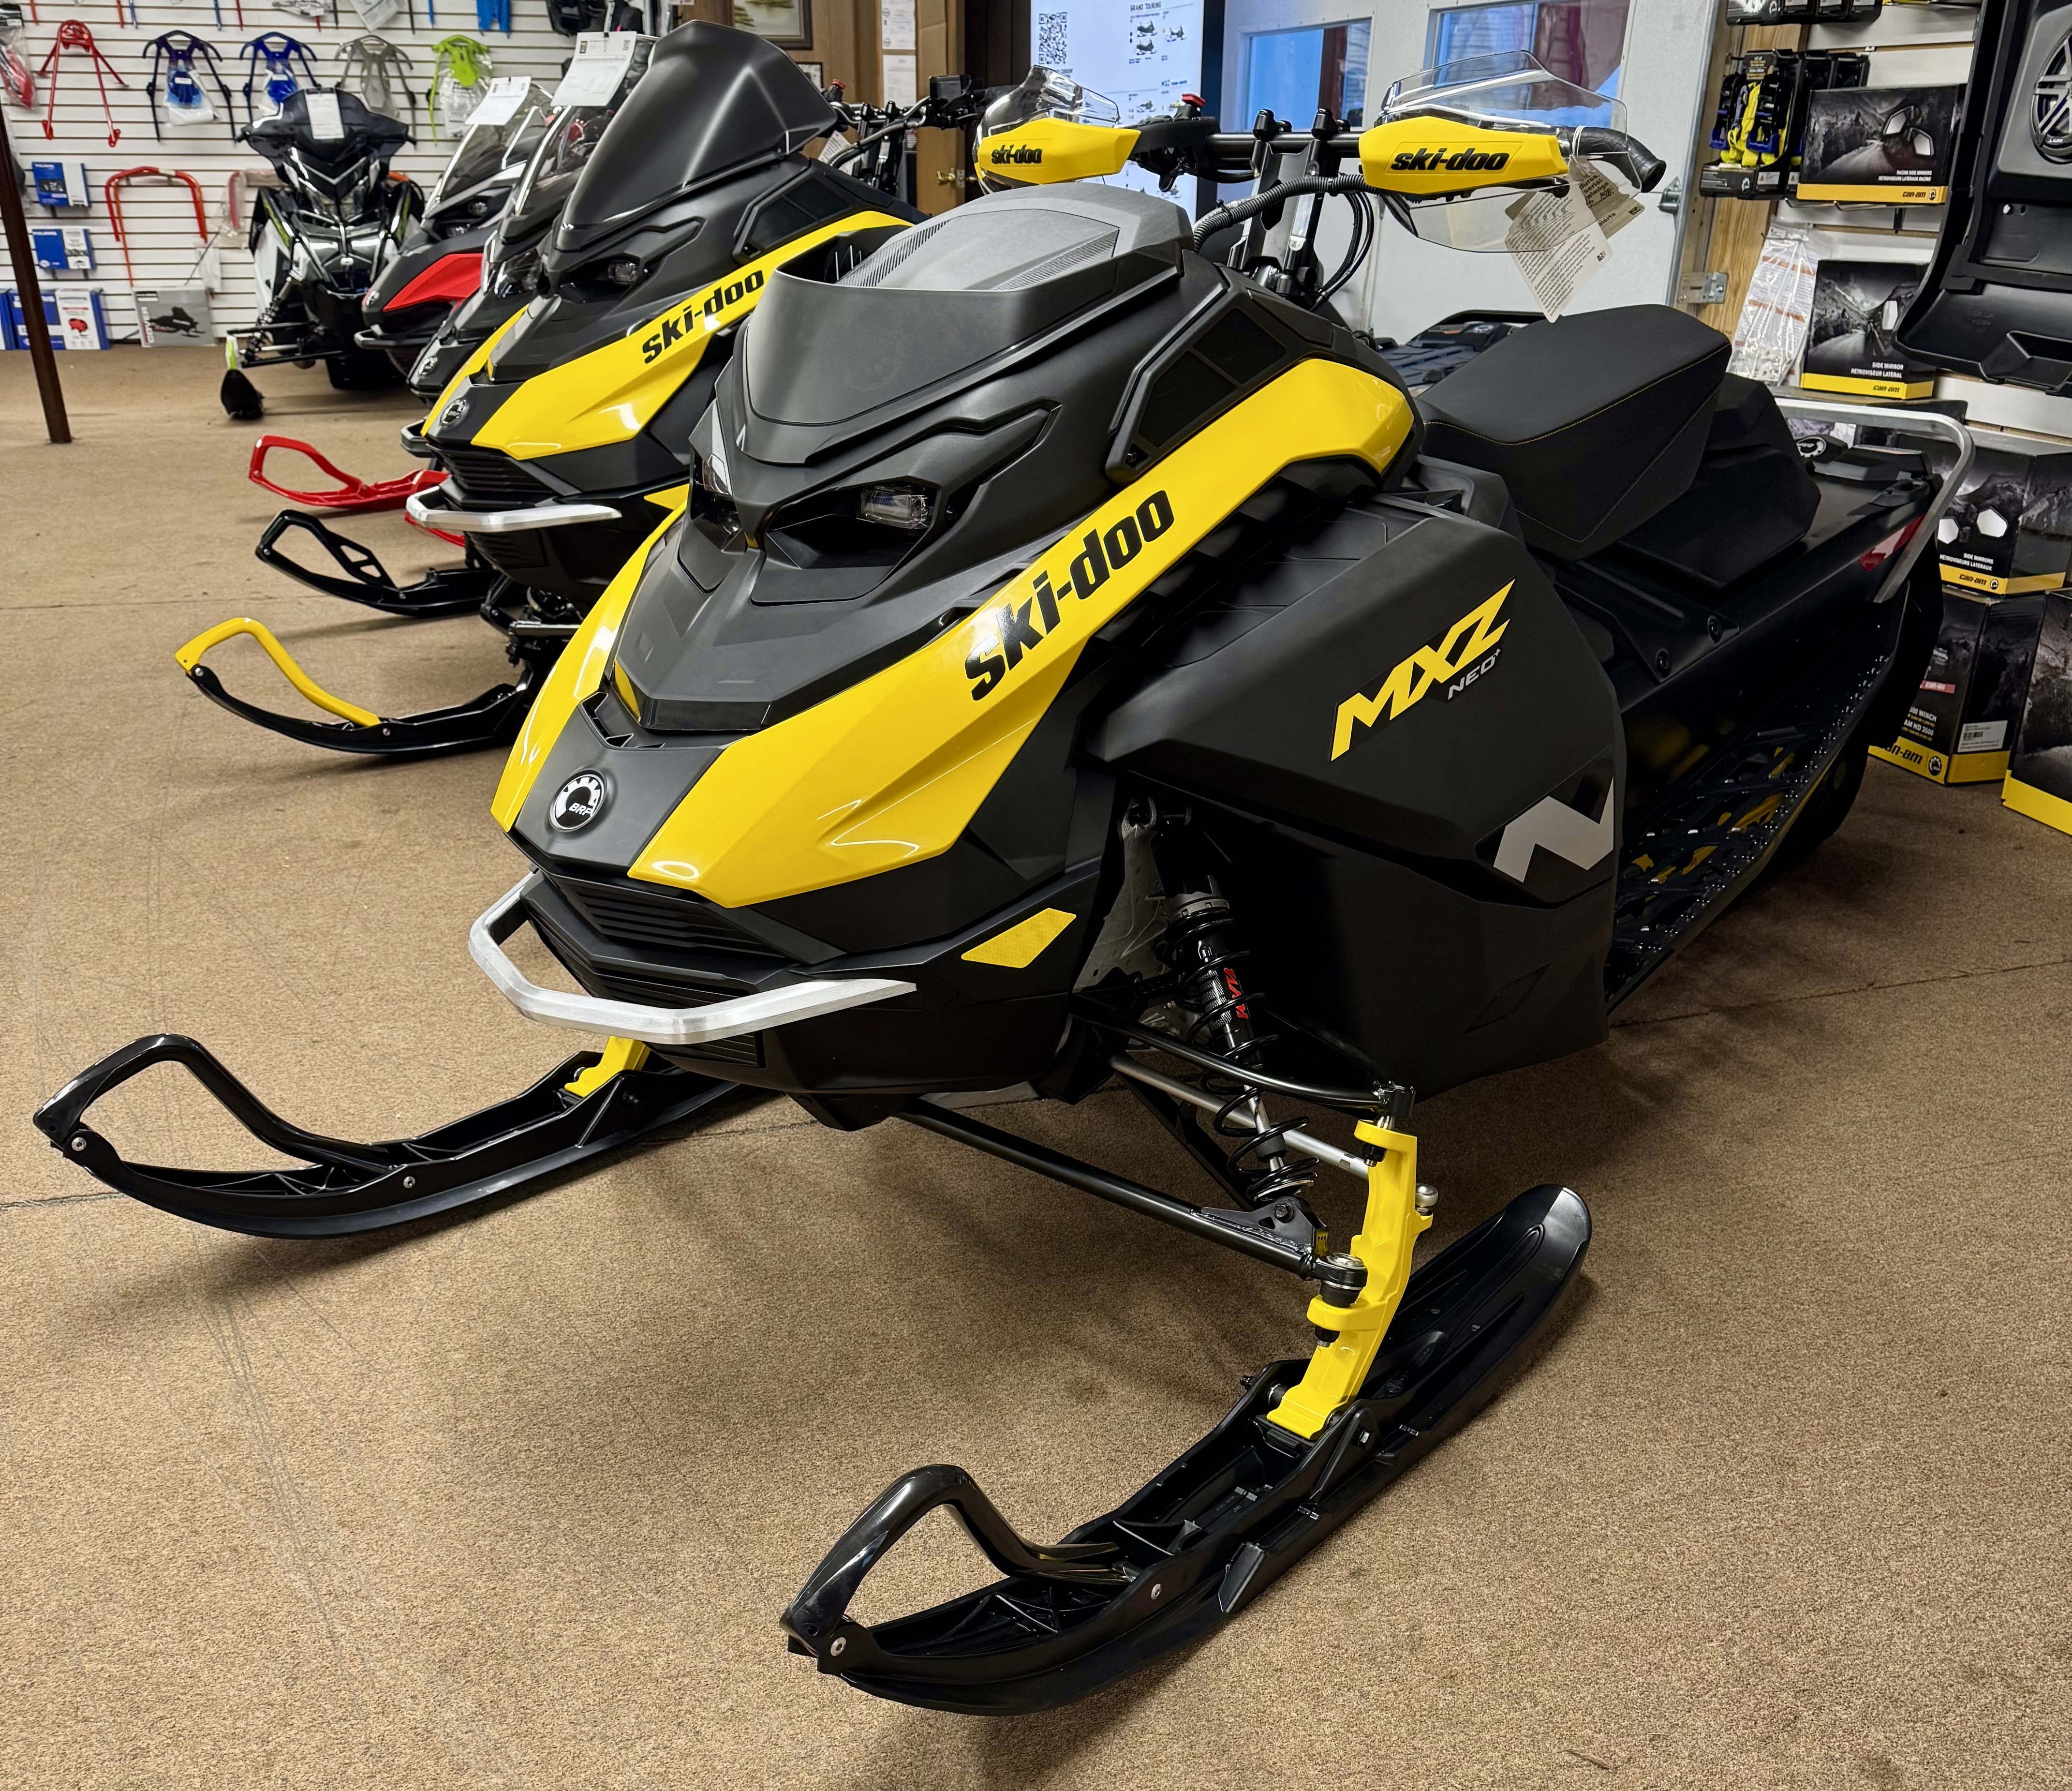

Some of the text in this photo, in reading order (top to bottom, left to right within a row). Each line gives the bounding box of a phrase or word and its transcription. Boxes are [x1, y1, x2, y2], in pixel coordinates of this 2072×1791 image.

[992, 144, 1042, 164] ski-doo
[1391, 148, 1510, 171] ski-doo
[642, 270, 764, 364] ski-doo
[1974, 555, 1994, 564] MIRRORS
[1959, 574, 1987, 585] can-am
[964, 490, 1174, 701] ski-doo
[1331, 579, 1515, 761] MXZ
[1919, 709, 1937, 722] WINCH
[1913, 722, 1922, 731] HD
[1922, 726, 1934, 736] 3500
[568, 802, 593, 816] BRP
